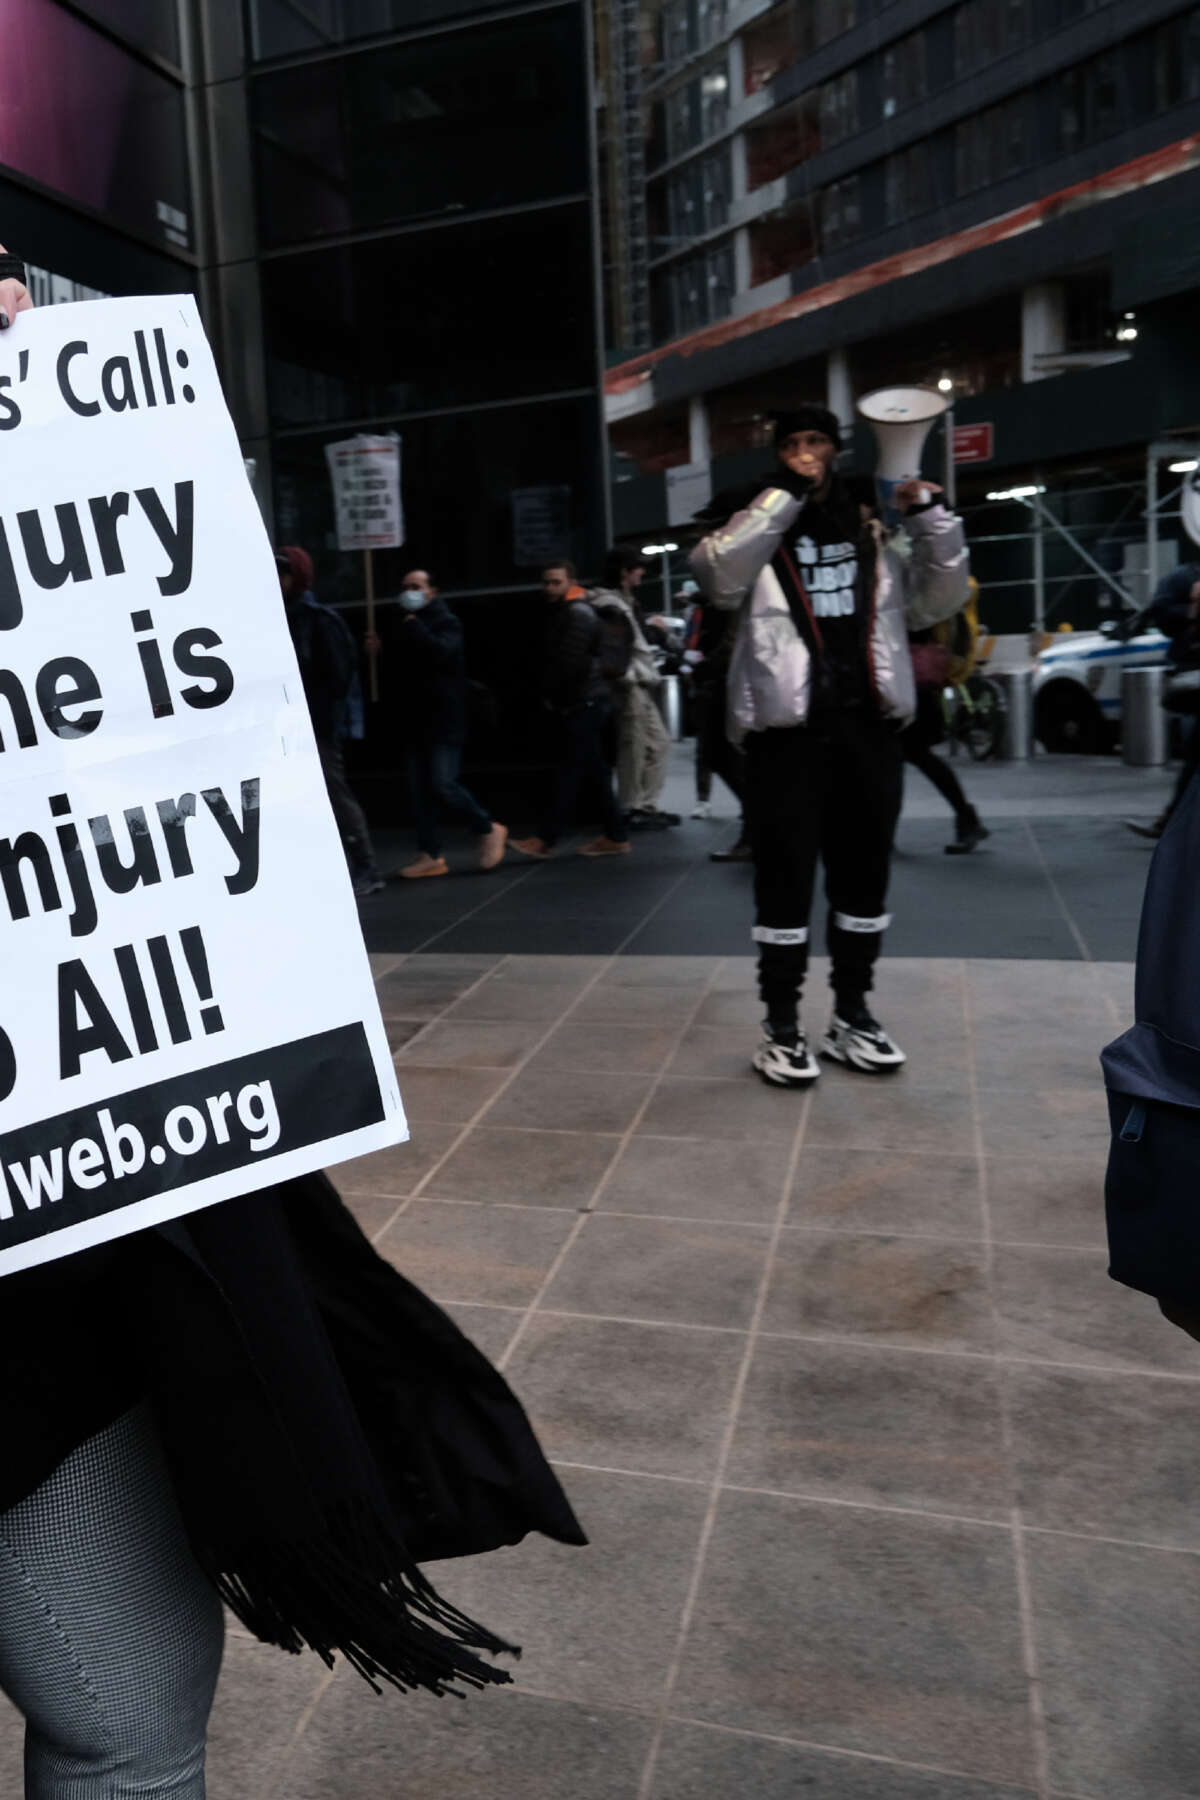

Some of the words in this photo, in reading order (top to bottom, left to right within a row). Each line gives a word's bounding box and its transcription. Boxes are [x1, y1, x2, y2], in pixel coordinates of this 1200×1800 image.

[56, 327, 197, 418] Call:
[129, 608, 235, 720] is
[56, 925, 226, 1081] All!
